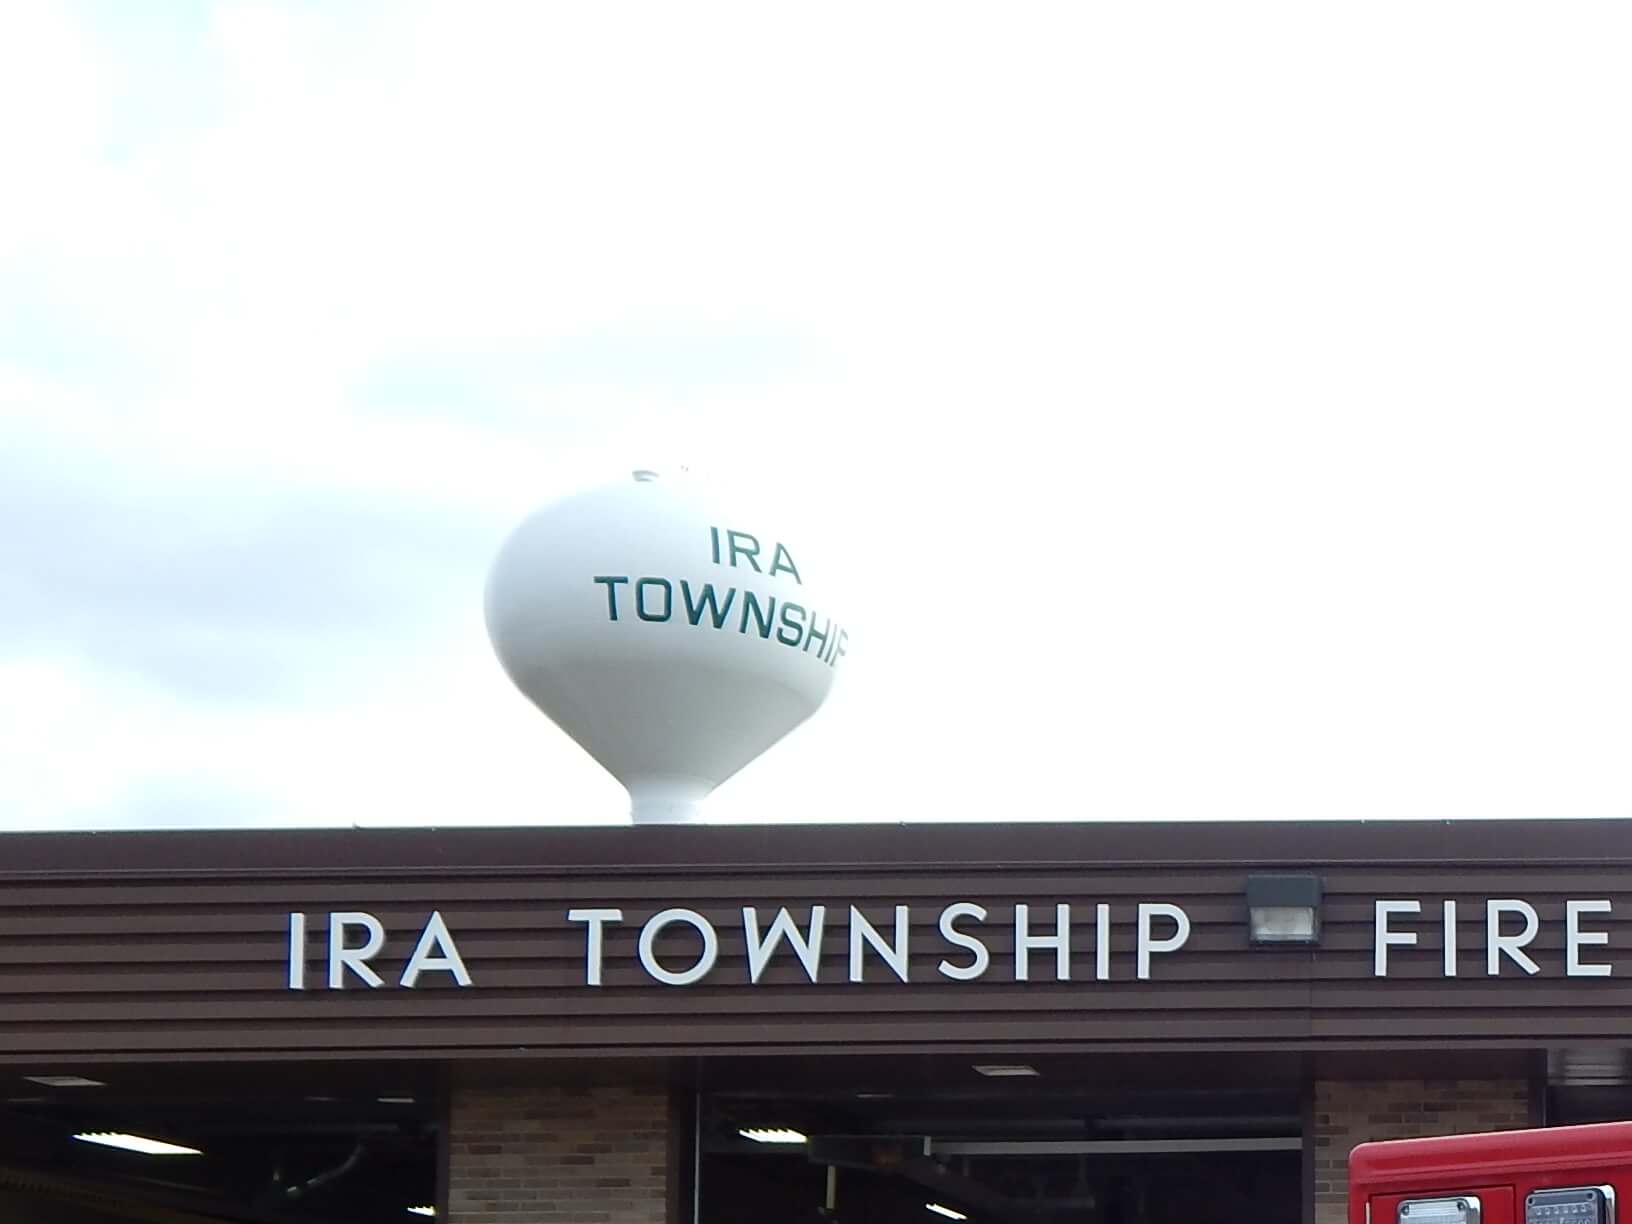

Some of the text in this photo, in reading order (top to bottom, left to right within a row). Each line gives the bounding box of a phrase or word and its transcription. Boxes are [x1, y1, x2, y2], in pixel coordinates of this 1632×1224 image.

[709, 525, 802, 585] IRA
[594, 575, 850, 668] TOWNSHIP
[288, 910, 473, 990] IRA
[567, 902, 1191, 986] TOWNSHIP
[1374, 899, 1613, 977] FIRE
